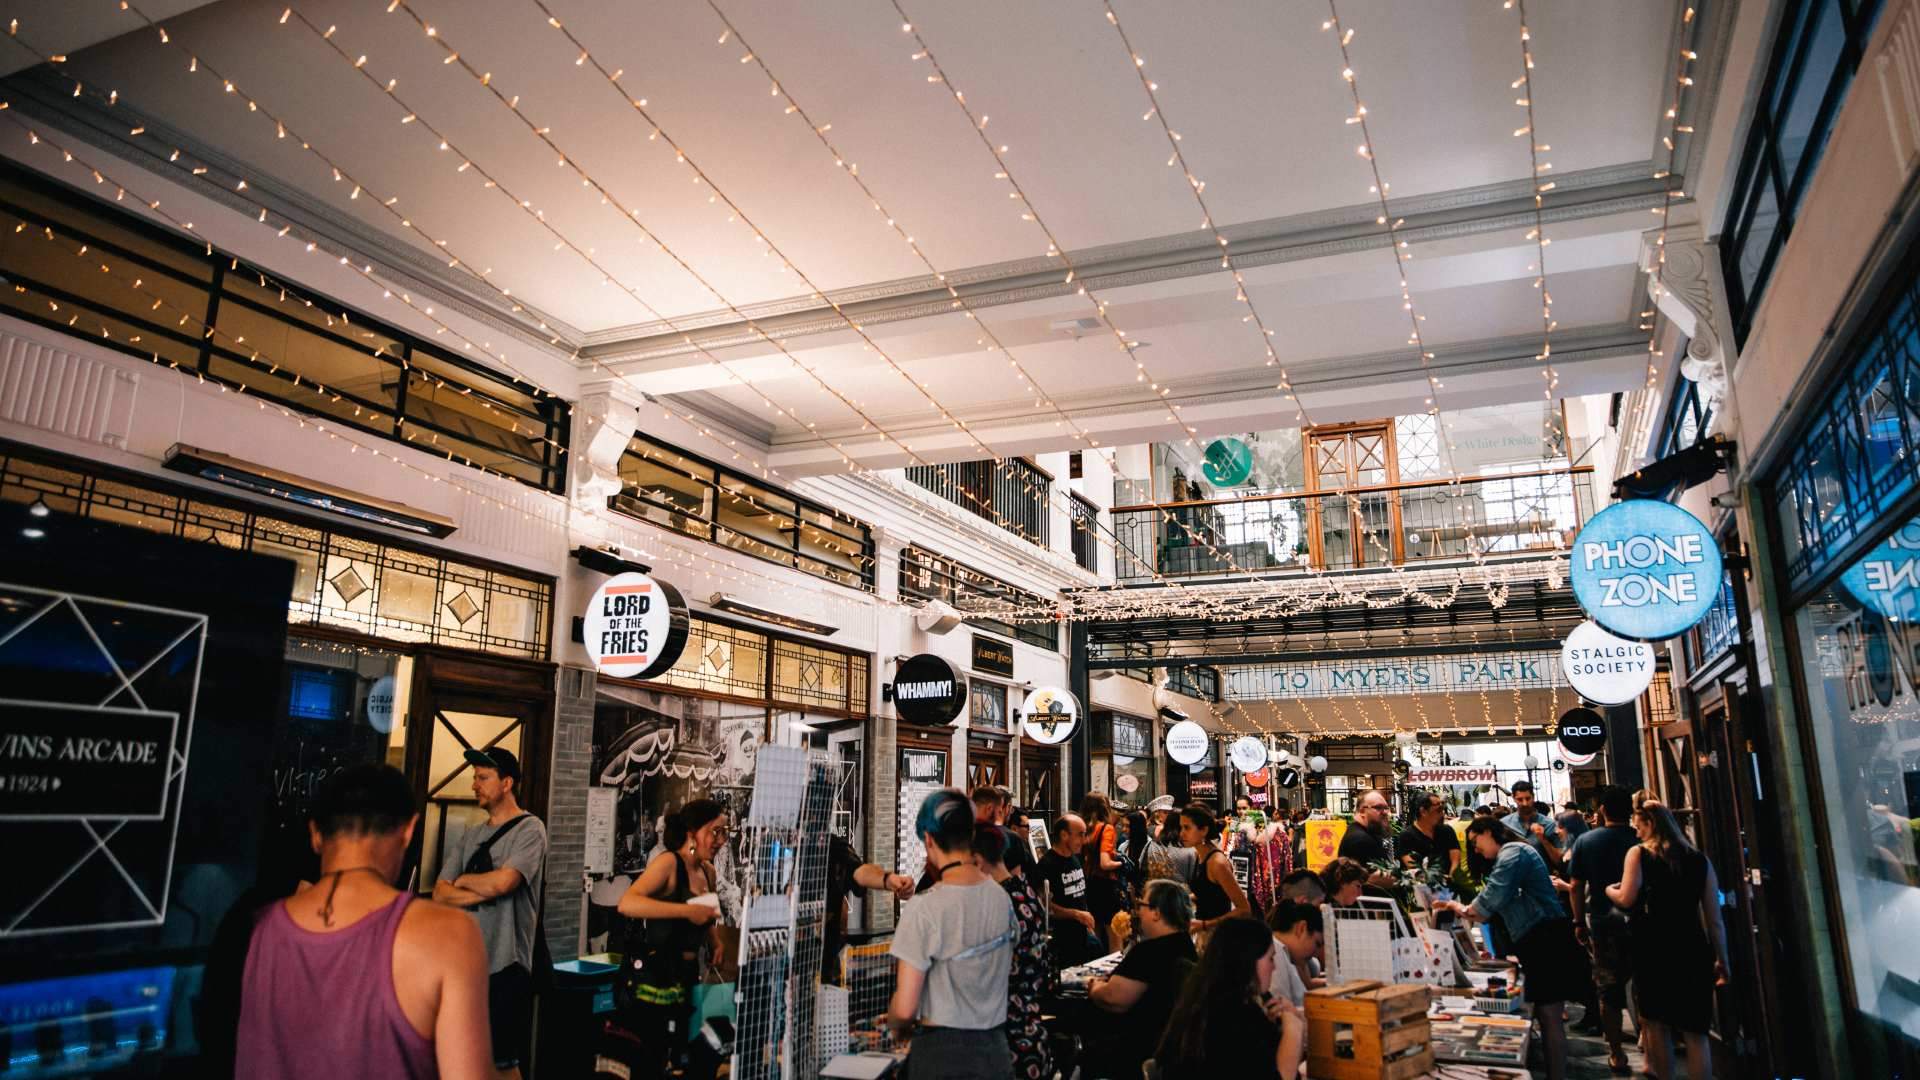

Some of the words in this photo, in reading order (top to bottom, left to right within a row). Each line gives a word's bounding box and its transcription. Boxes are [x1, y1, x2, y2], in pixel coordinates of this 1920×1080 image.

[1583, 533, 1704, 571] PHONE
[1599, 571, 1697, 607] ZONE
[603, 594, 650, 617] LORD
[609, 618, 621, 630] OF
[625, 617, 643, 629] THE
[600, 629, 649, 655] FRIES
[1571, 645, 1645, 660] STALGIC
[1273, 672, 1309, 690] TO
[1331, 664, 1430, 689] MYERS
[1459, 660, 1543, 683] PARK
[1573, 661, 1646, 675] SOCIETY
[897, 680, 952, 700] WHAMMY!
[1563, 725, 1602, 736] IQOS
[59, 737, 158, 764] ARCADE
[9, 775, 48, 792] 1924
[1408, 769, 1494, 783] LOWBROW
